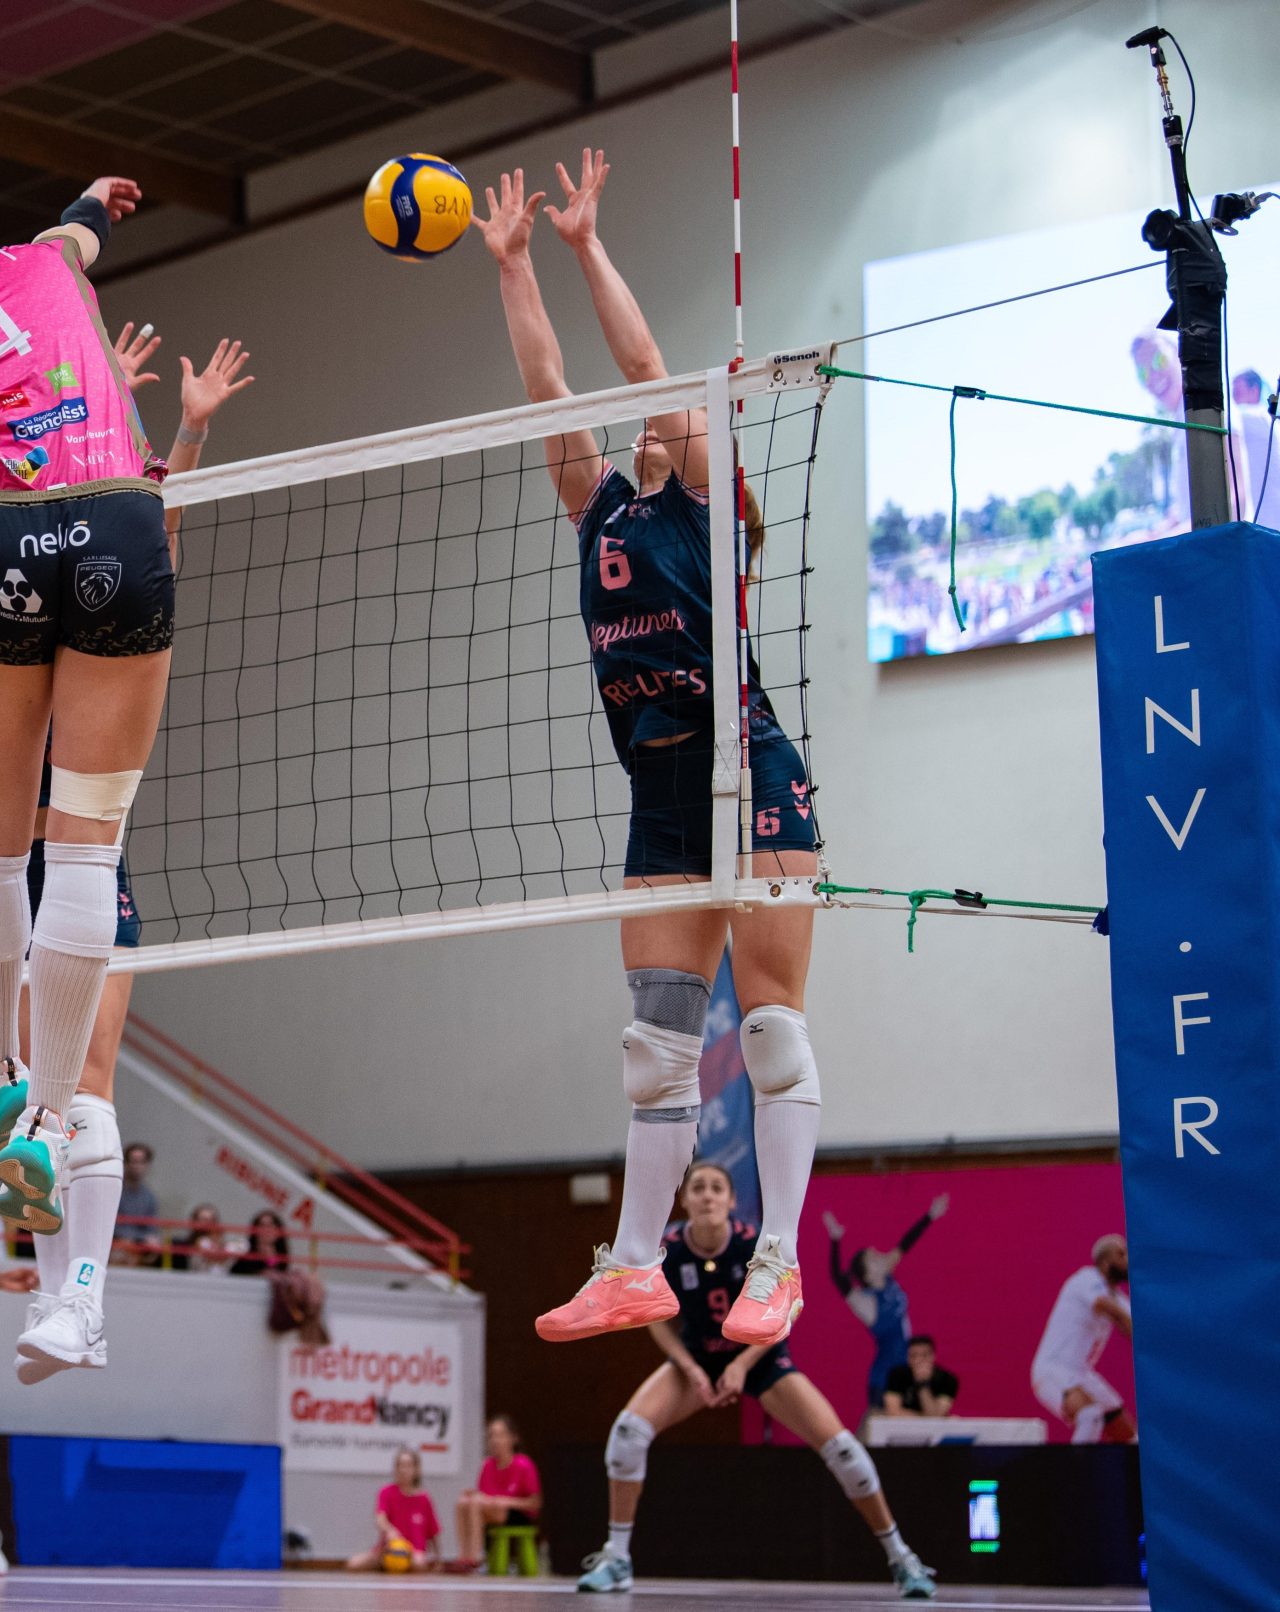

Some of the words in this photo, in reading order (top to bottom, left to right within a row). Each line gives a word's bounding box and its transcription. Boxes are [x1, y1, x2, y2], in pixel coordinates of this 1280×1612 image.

[781, 351, 820, 364] Senoh
[599, 535, 632, 591] 6
[756, 806, 781, 838] 6
[707, 1288, 731, 1324] 9
